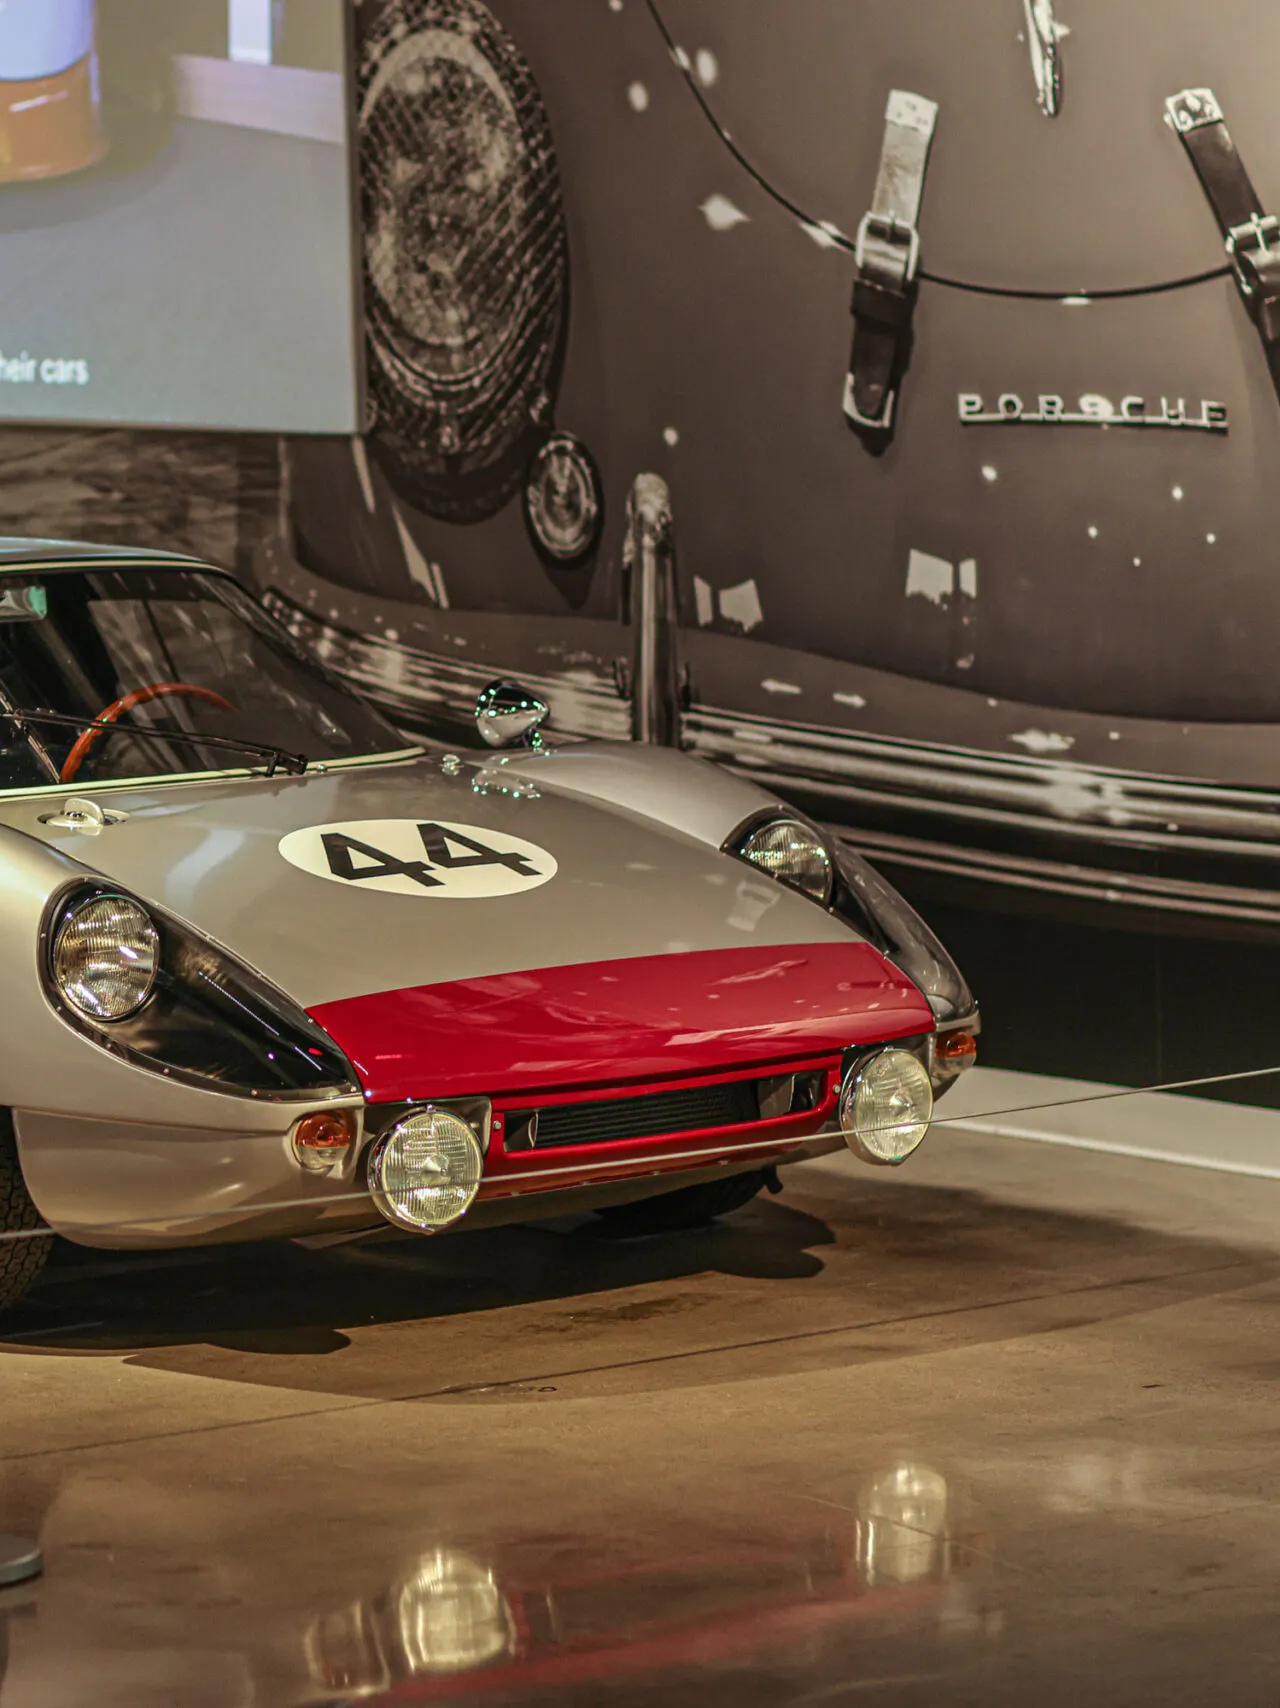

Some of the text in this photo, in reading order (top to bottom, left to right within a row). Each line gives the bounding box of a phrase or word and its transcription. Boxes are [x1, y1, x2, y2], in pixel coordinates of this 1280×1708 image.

[40, 358, 89, 385] cars
[958, 393, 1228, 429] PORSCHE
[320, 822, 543, 888] 44
